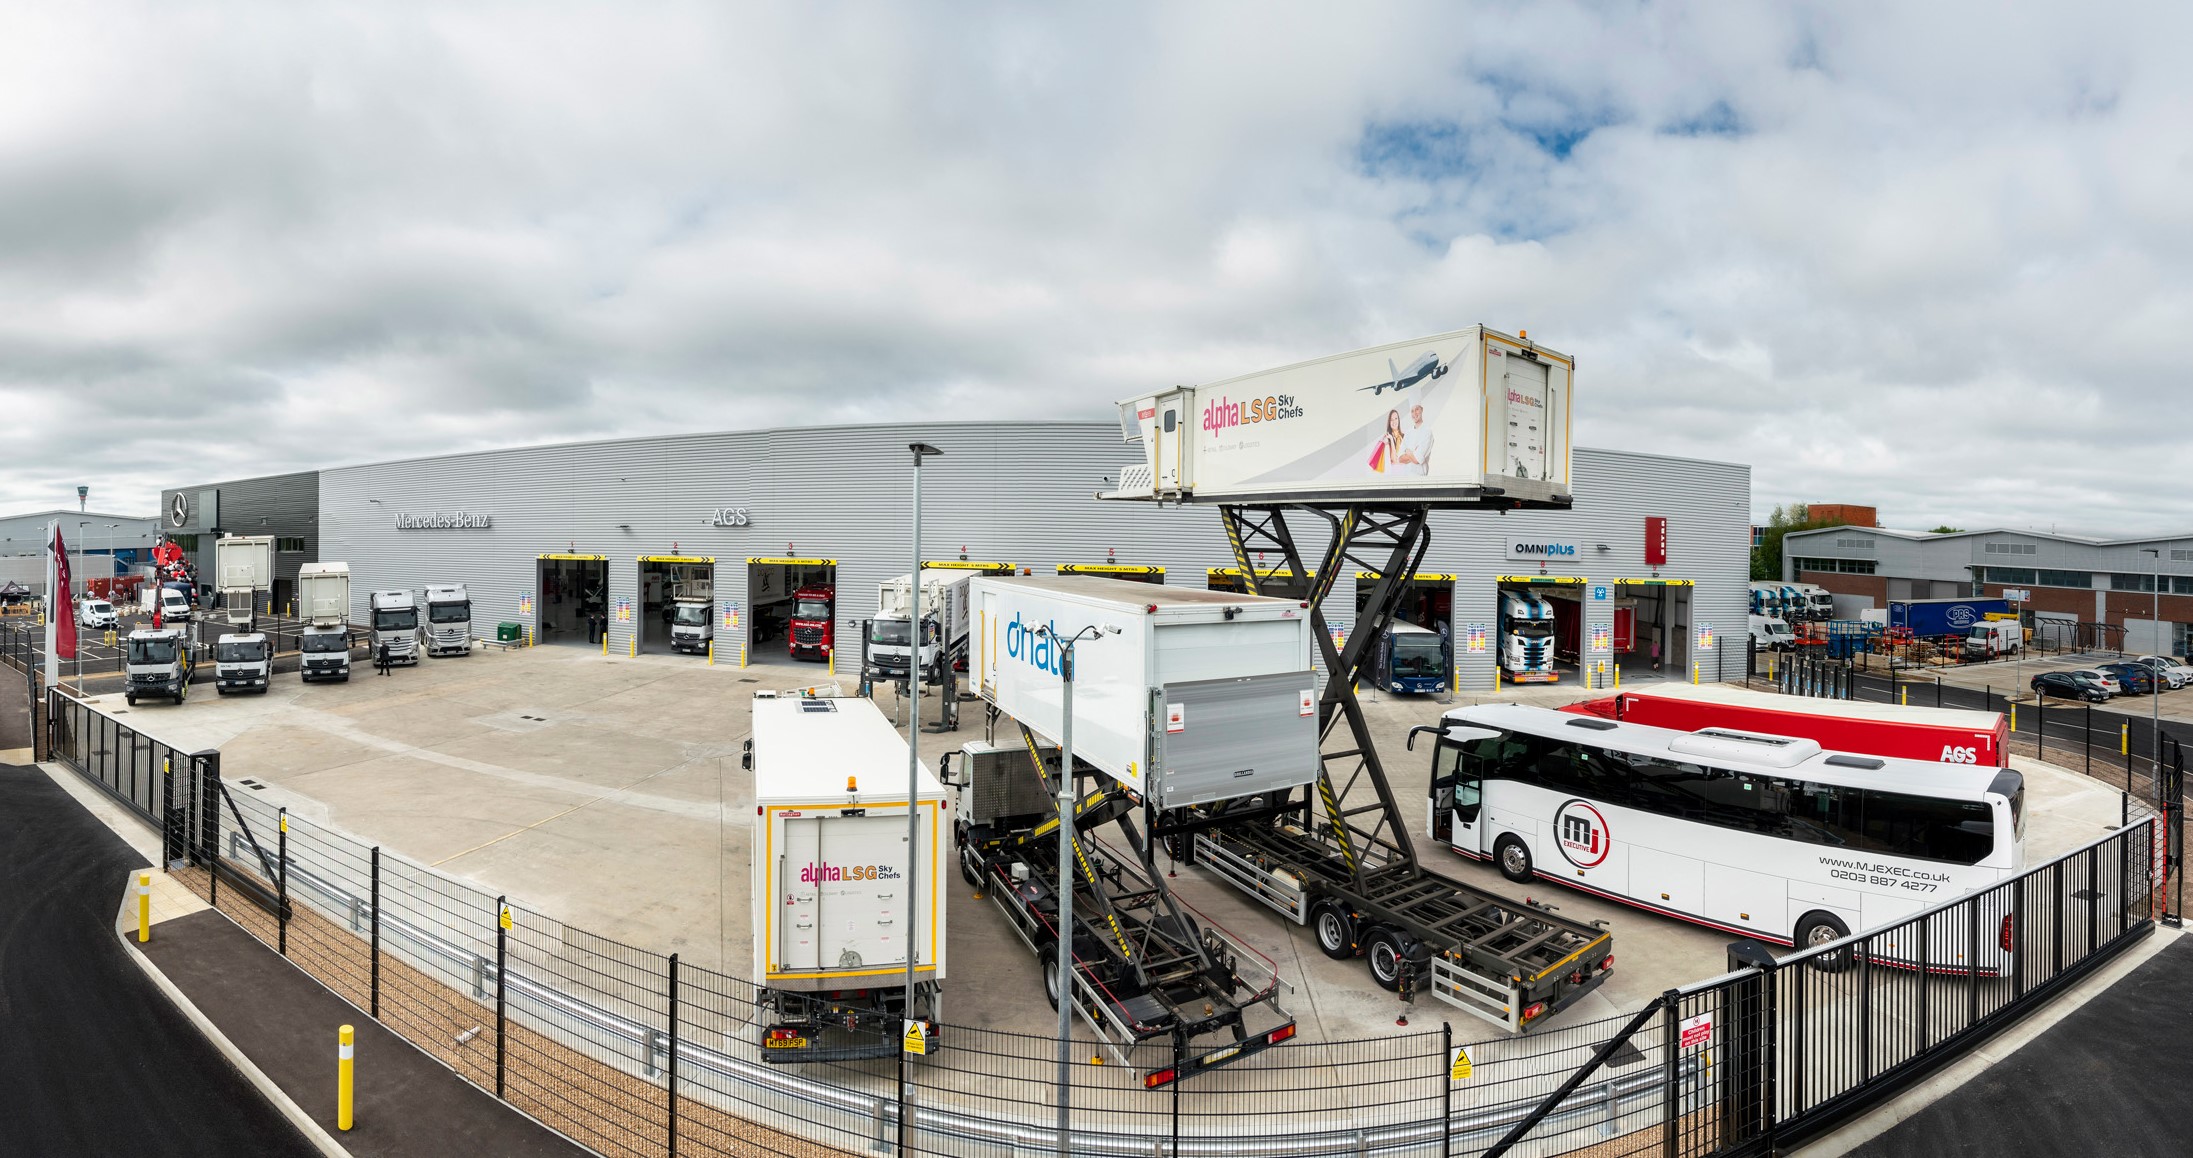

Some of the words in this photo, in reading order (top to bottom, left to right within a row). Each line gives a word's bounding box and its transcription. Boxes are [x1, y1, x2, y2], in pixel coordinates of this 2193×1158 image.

[1278, 395, 1294, 407] Sky
[1204, 397, 1238, 438] alpha
[1241, 397, 1277, 424] LSG
[1278, 406, 1303, 419] Chefs
[395, 511, 489, 528] Mercedes-Benz
[712, 508, 747, 525] AGS
[1109, 548, 1114, 556] 5
[1259, 552, 1264, 560] 6
[1515, 543, 1574, 556] OMNIplus
[1940, 745, 1976, 764] AGS
[1564, 840, 1589, 852] EXECUTIVE
[801, 862, 840, 887] alpha
[842, 866, 877, 880] LSG
[878, 865, 892, 873] Sky
[1819, 857, 1950, 883] www.MJEXEC.co.uk
[1831, 869, 1866, 882] 0203
[1870, 876, 1897, 887] 887
[1901, 881, 1937, 893] 4277
